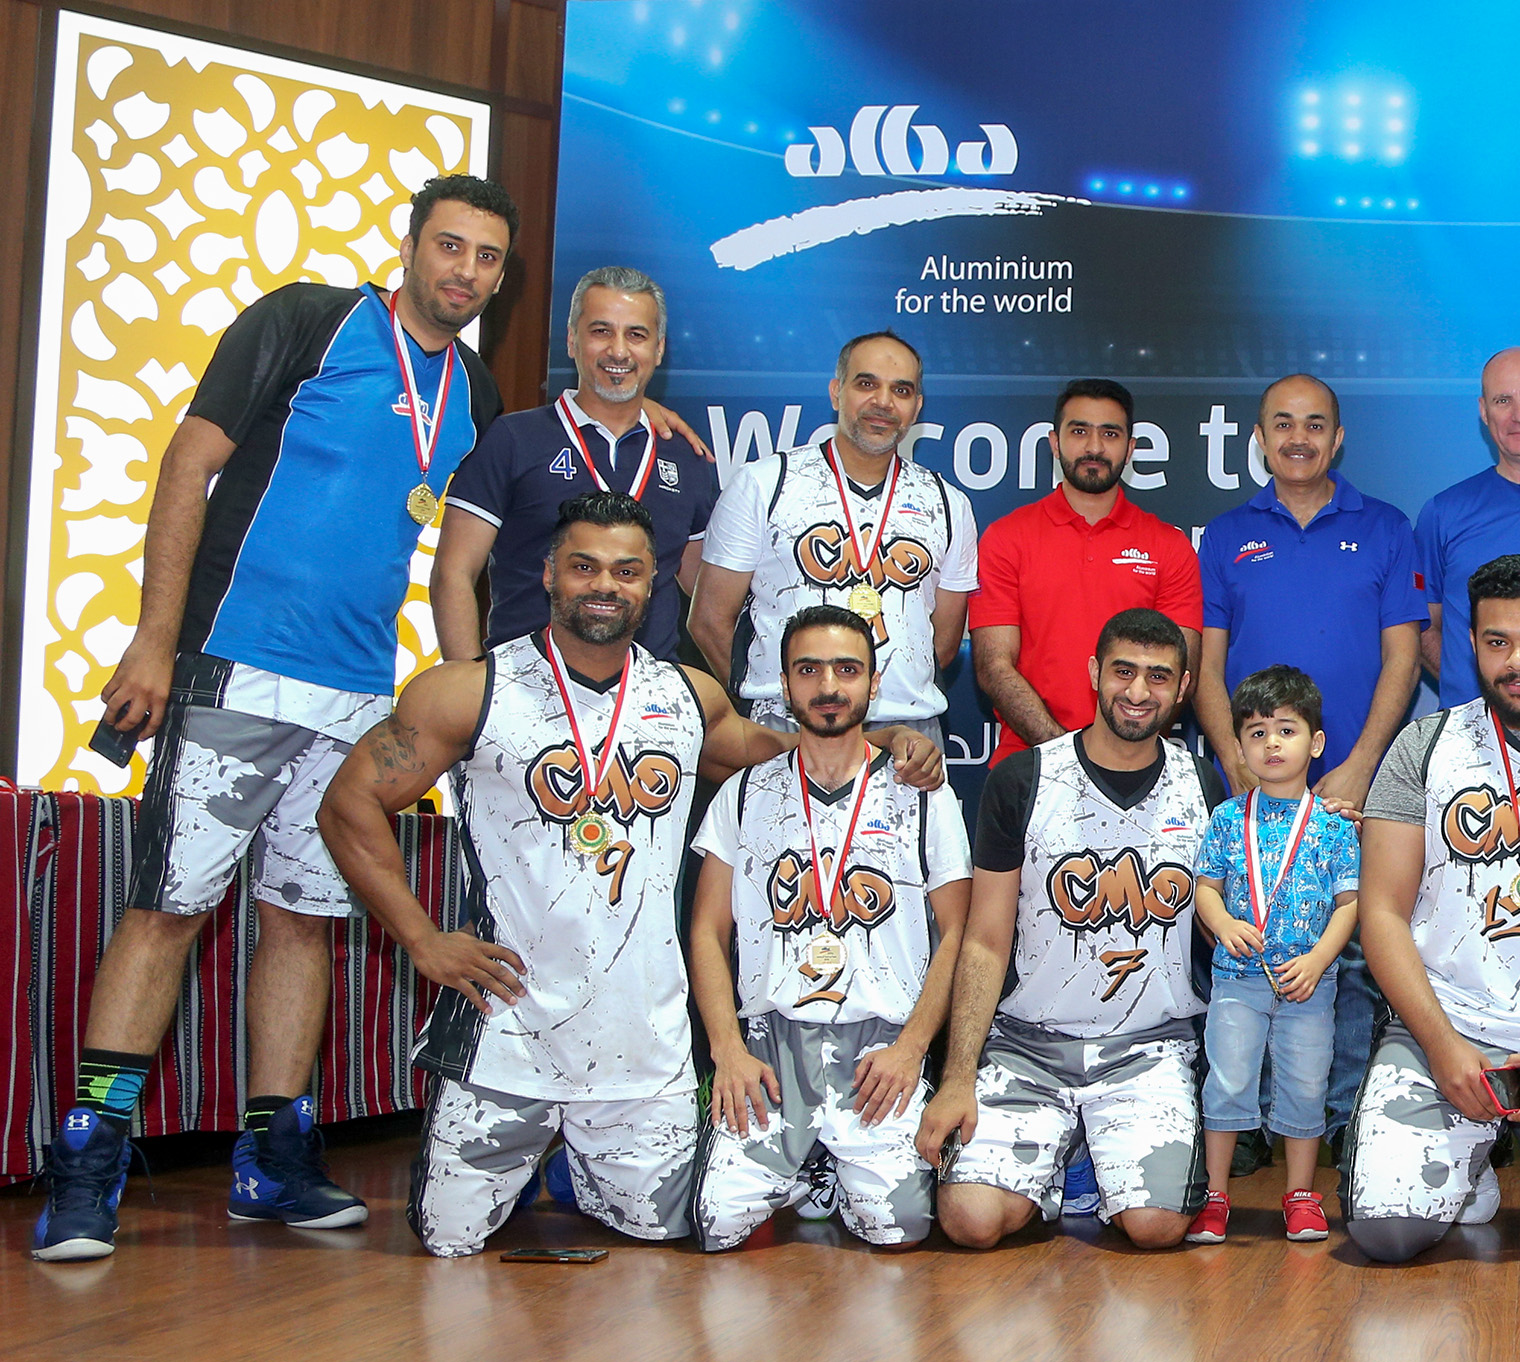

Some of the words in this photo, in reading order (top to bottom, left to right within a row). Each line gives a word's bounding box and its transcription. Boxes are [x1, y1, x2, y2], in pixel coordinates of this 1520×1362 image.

[784, 104, 1019, 177] alba
[920, 254, 1074, 281] Aluminium
[894, 287, 935, 314] for
[940, 287, 986, 314] the
[992, 287, 1073, 314] world
[549, 447, 578, 480] 4
[595, 840, 635, 906] 9
[1046, 847, 1195, 936] CMO
[1100, 949, 1149, 1003] 7
